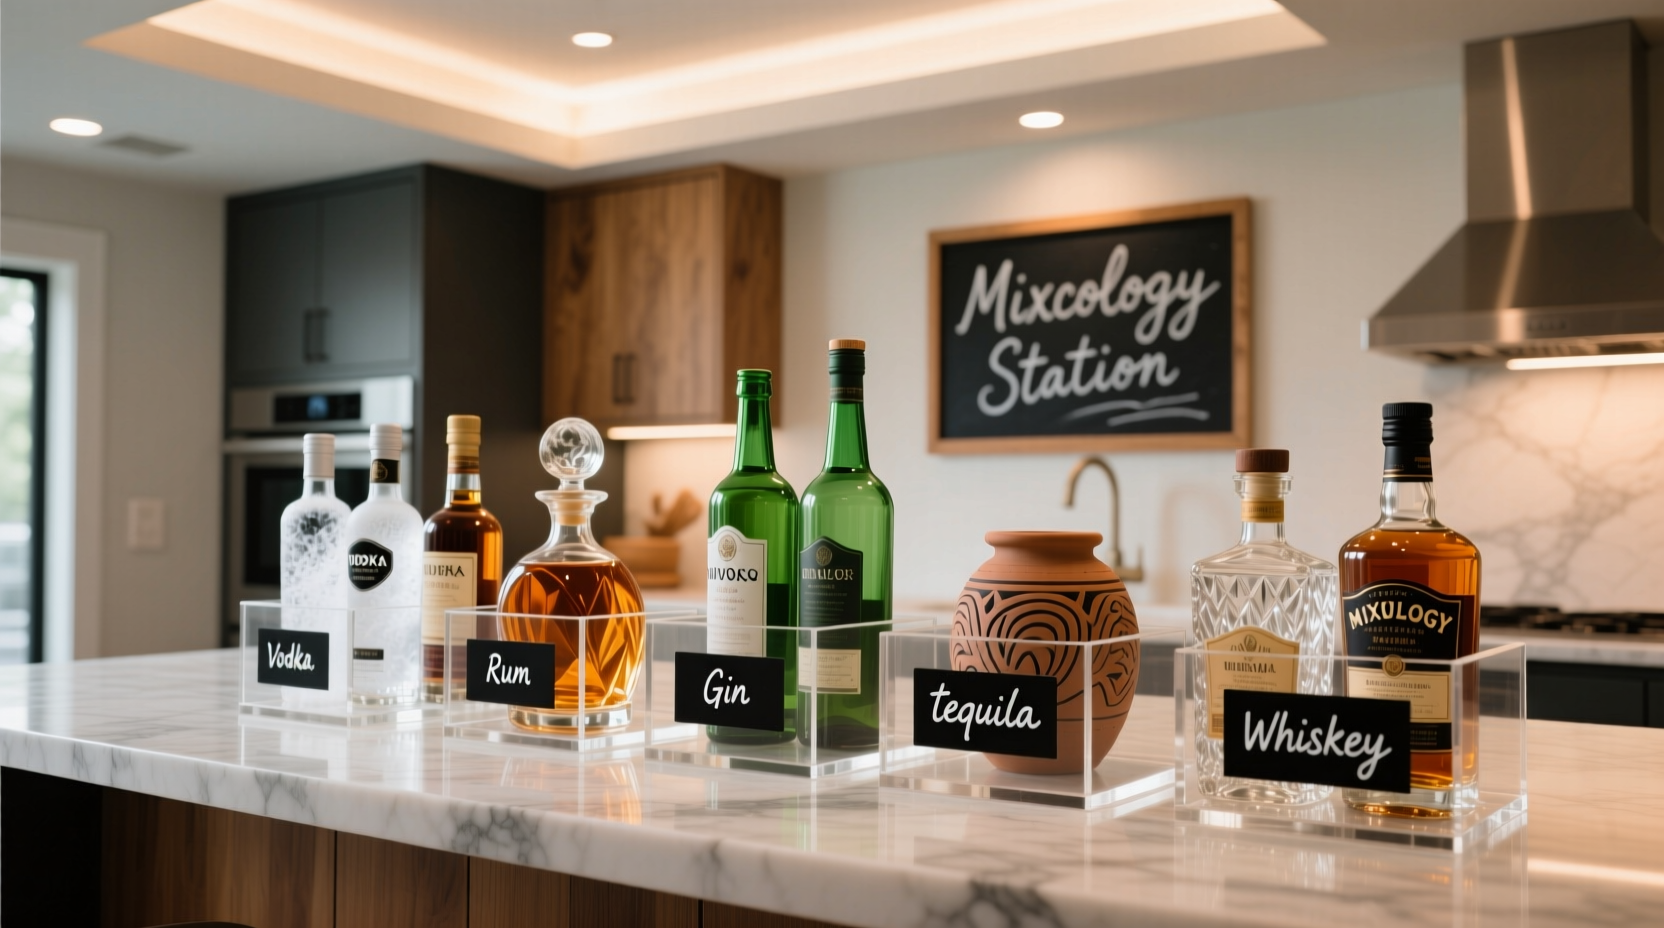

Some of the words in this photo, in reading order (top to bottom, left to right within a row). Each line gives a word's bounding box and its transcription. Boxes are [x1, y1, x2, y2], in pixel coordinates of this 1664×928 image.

[955, 243, 1221, 345] Mixcology
[976, 334, 1180, 417] Station
[267, 641, 315, 671] Vodka
[486, 652, 531, 685] Rum
[703, 668, 750, 709] Gin
[929, 682, 1042, 742] tequila
[1244, 710, 1393, 780] Whiskey
